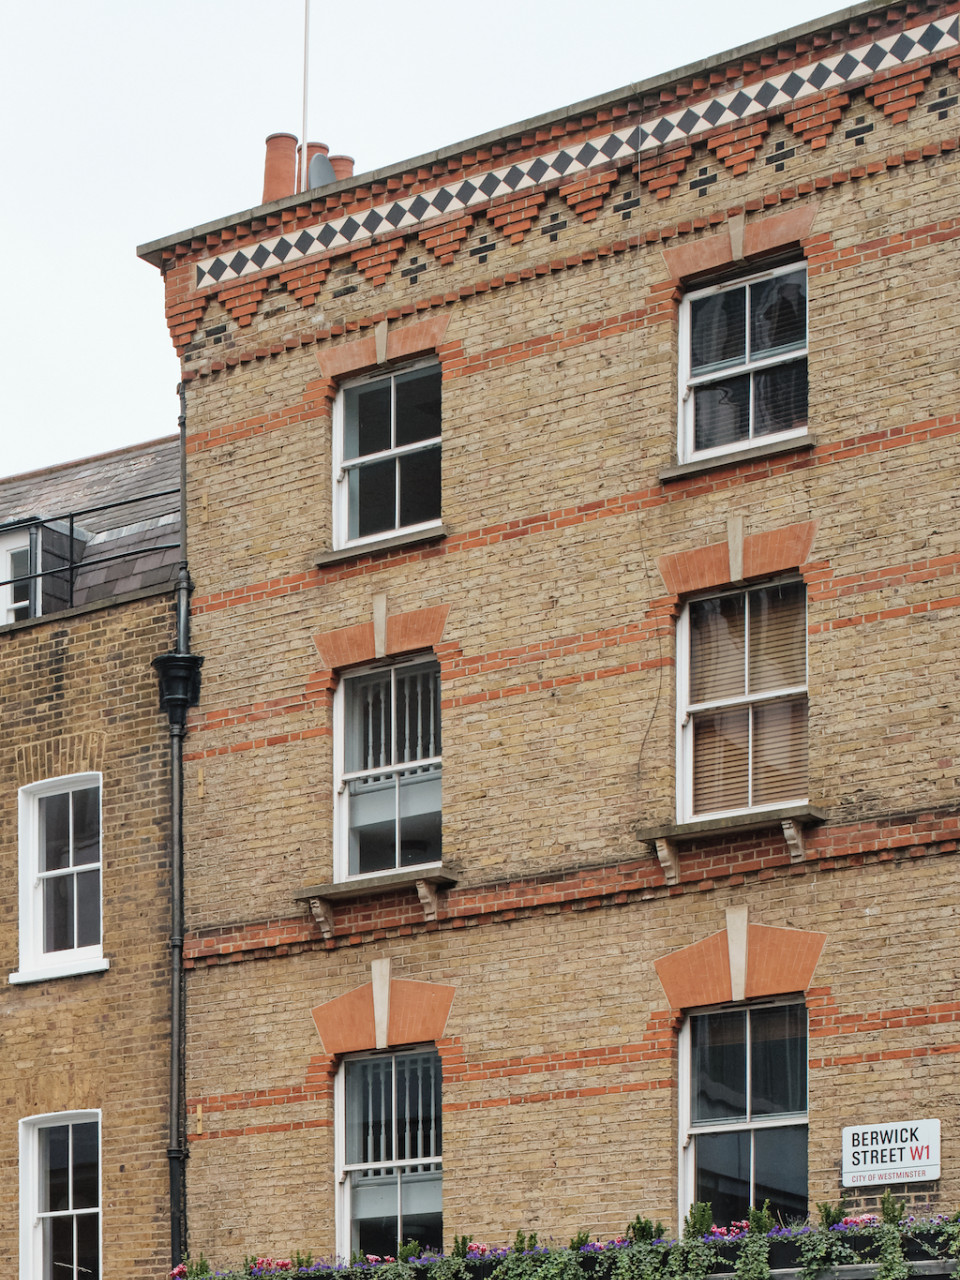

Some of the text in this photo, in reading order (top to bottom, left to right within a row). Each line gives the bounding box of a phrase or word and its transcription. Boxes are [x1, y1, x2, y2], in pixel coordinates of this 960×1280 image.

[852, 1127, 919, 1147] BERWICK
[852, 1144, 930, 1166] STREET W1
[851, 1175, 866, 1183] CITY
[878, 1170, 926, 1181] WESTMINSTER
